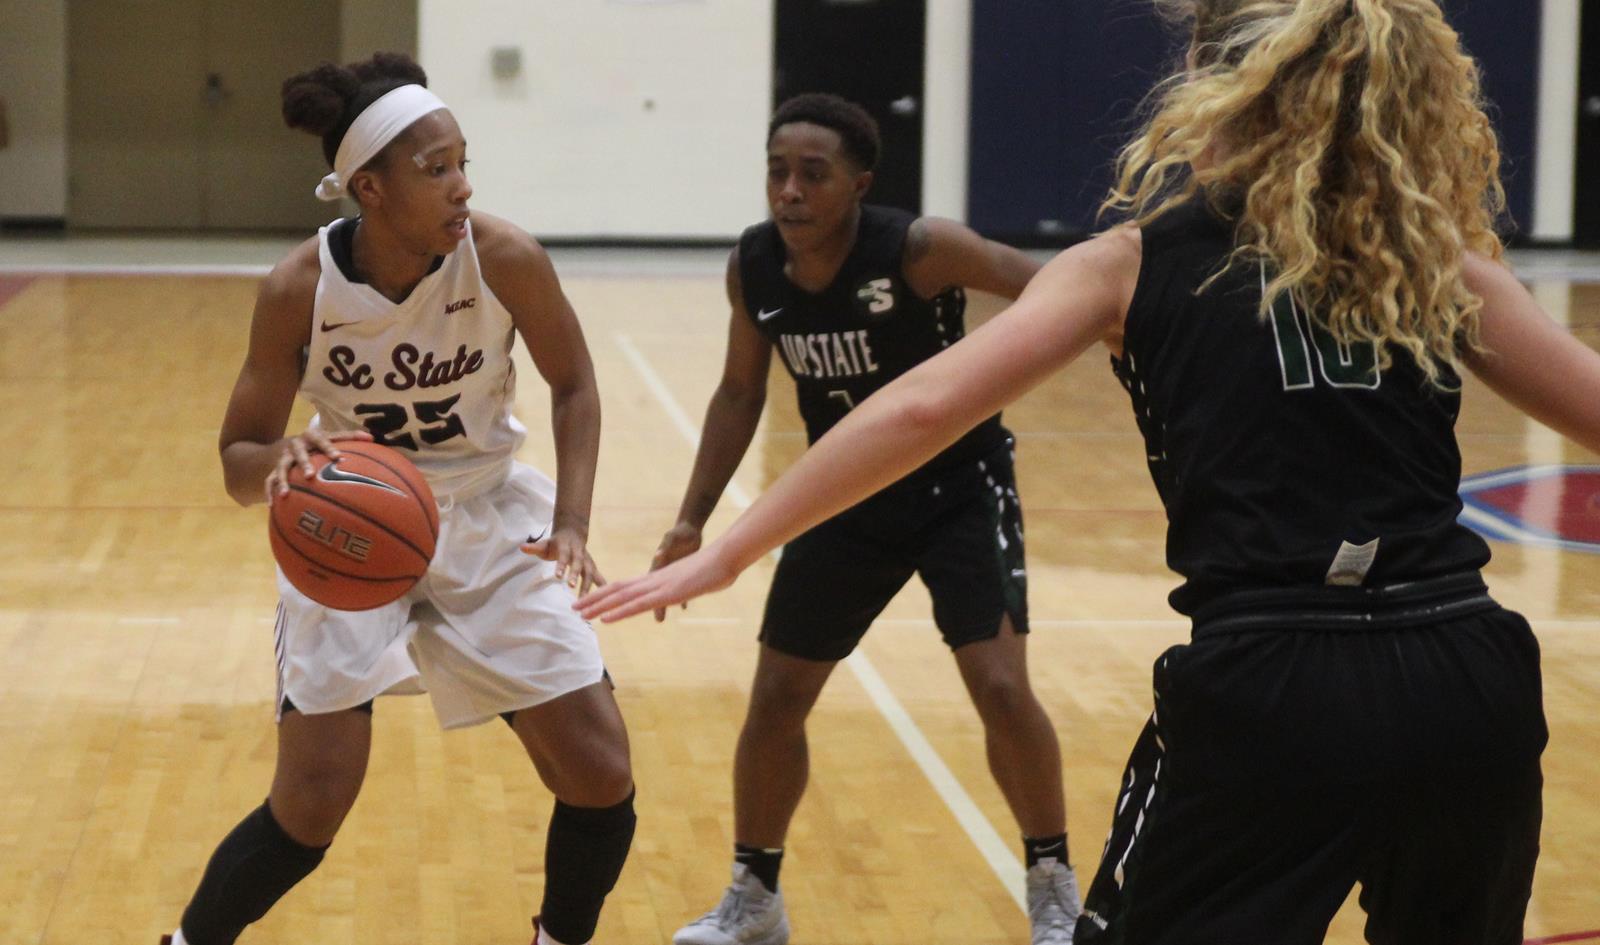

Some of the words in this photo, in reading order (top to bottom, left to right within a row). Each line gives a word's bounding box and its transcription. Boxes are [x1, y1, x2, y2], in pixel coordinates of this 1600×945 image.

[444, 298, 476, 315] MEAC
[384, 342, 484, 391] State
[780, 329, 879, 378] UPSTATE
[353, 392, 467, 451] 25
[296, 508, 373, 564] ELITE
